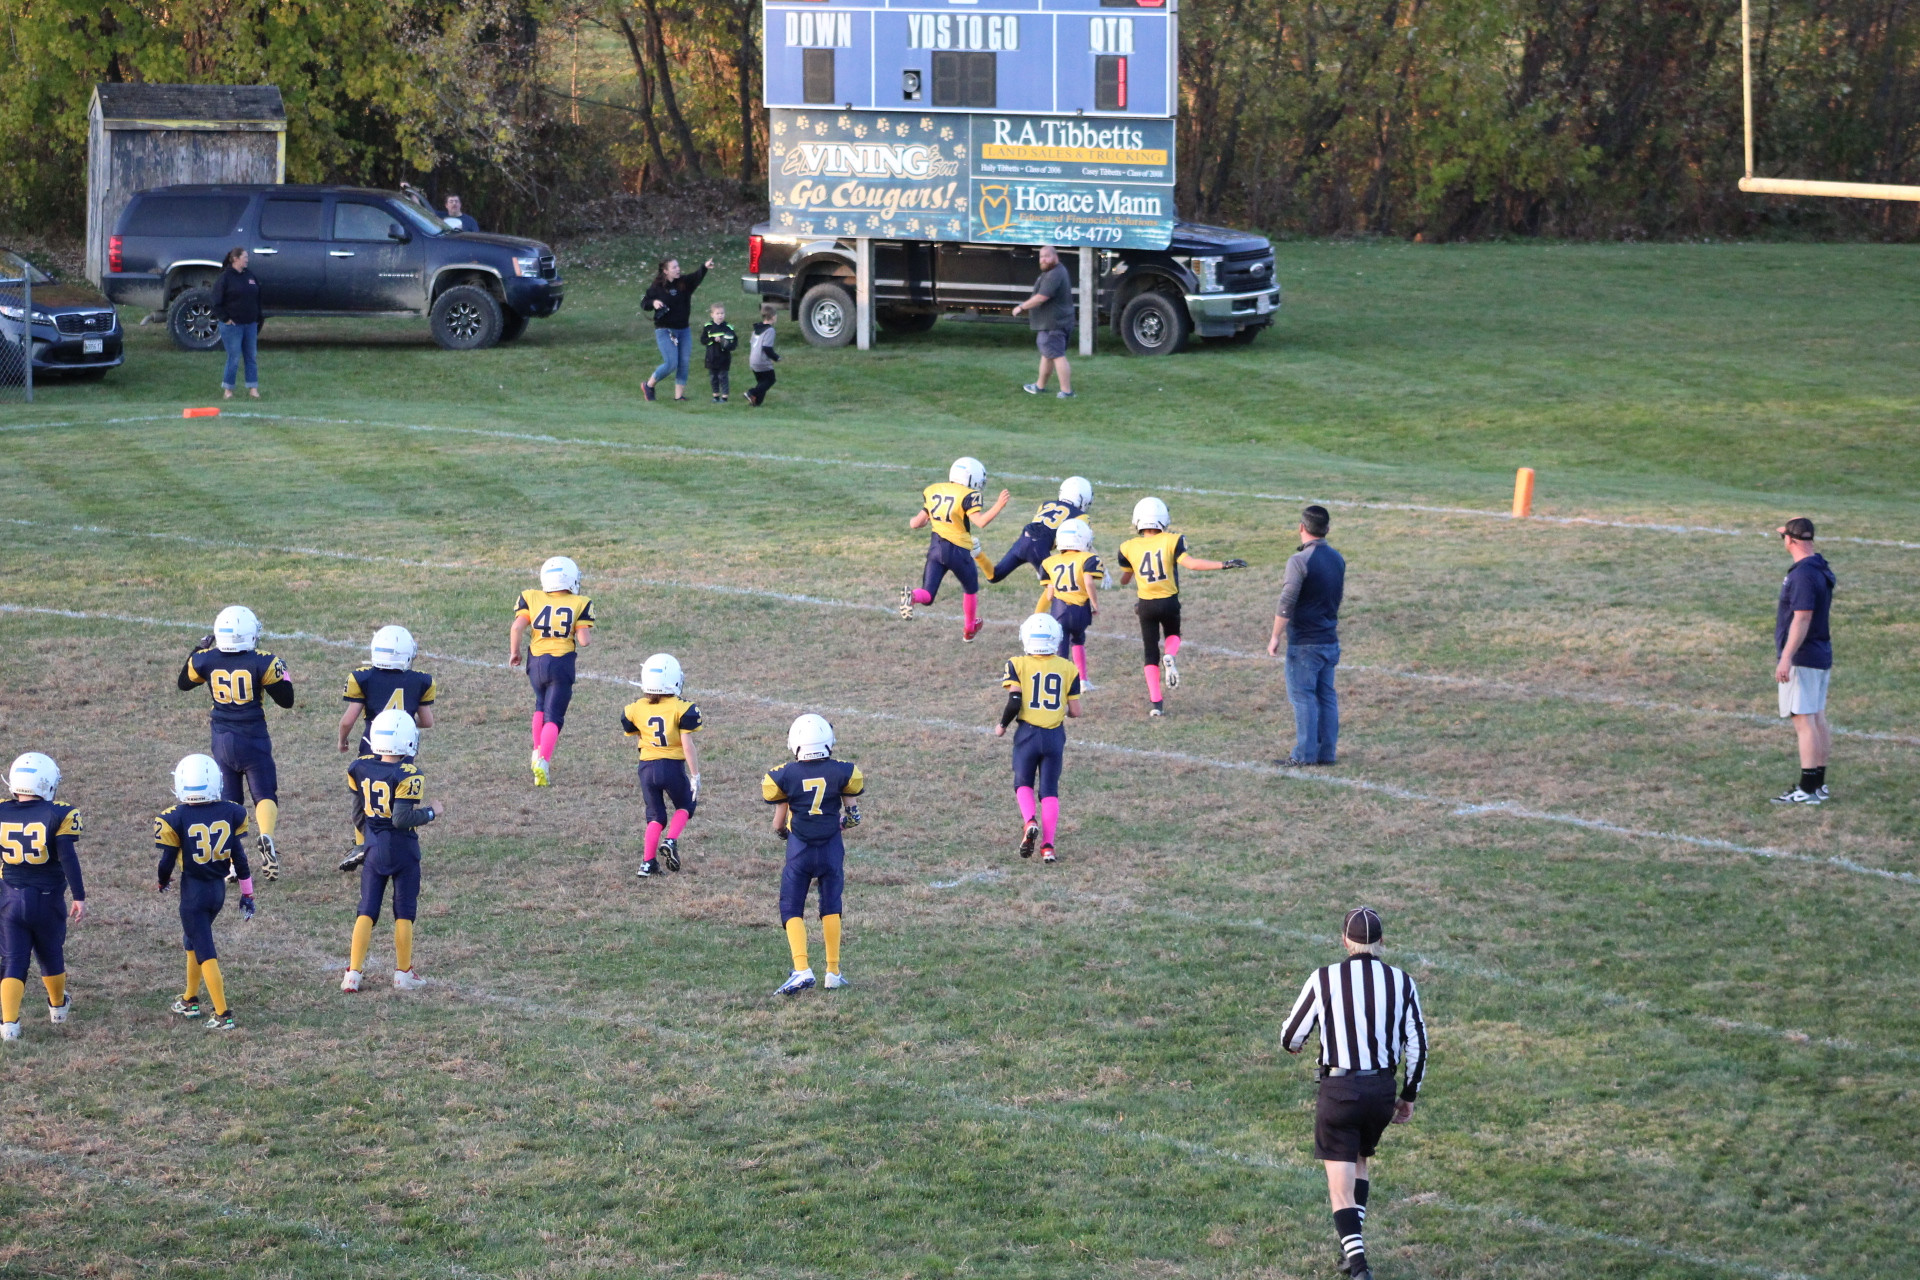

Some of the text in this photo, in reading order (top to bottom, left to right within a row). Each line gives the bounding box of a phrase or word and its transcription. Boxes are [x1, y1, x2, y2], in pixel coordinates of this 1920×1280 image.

[785, 12, 852, 48] DOWN
[908, 14, 1018, 51] YDS TO GO
[1090, 17, 1134, 53] QTR
[799, 143, 932, 178] VINING
[988, 147, 1027, 158] LAND
[1031, 149, 1072, 160] SALES
[1088, 151, 1161, 163] TRUCKING
[790, 179, 957, 220] Go Cougars!
[1014, 186, 1162, 216] Horace Mann
[1019, 213, 1158, 226] Educated Financial Solutions
[1054, 225, 1122, 243] 645-4779
[930, 493, 955, 524] 27
[1032, 502, 1070, 530] 23
[1053, 562, 1080, 593] 21
[1138, 548, 1167, 584] 41
[532, 605, 573, 639] 43
[210, 669, 253, 705] 60
[1029, 671, 1062, 711] 19
[647, 716, 668, 747] 3
[361, 777, 392, 818] 13
[802, 777, 827, 816] 7
[0, 822, 50, 866] 53
[187, 820, 232, 865] 32
